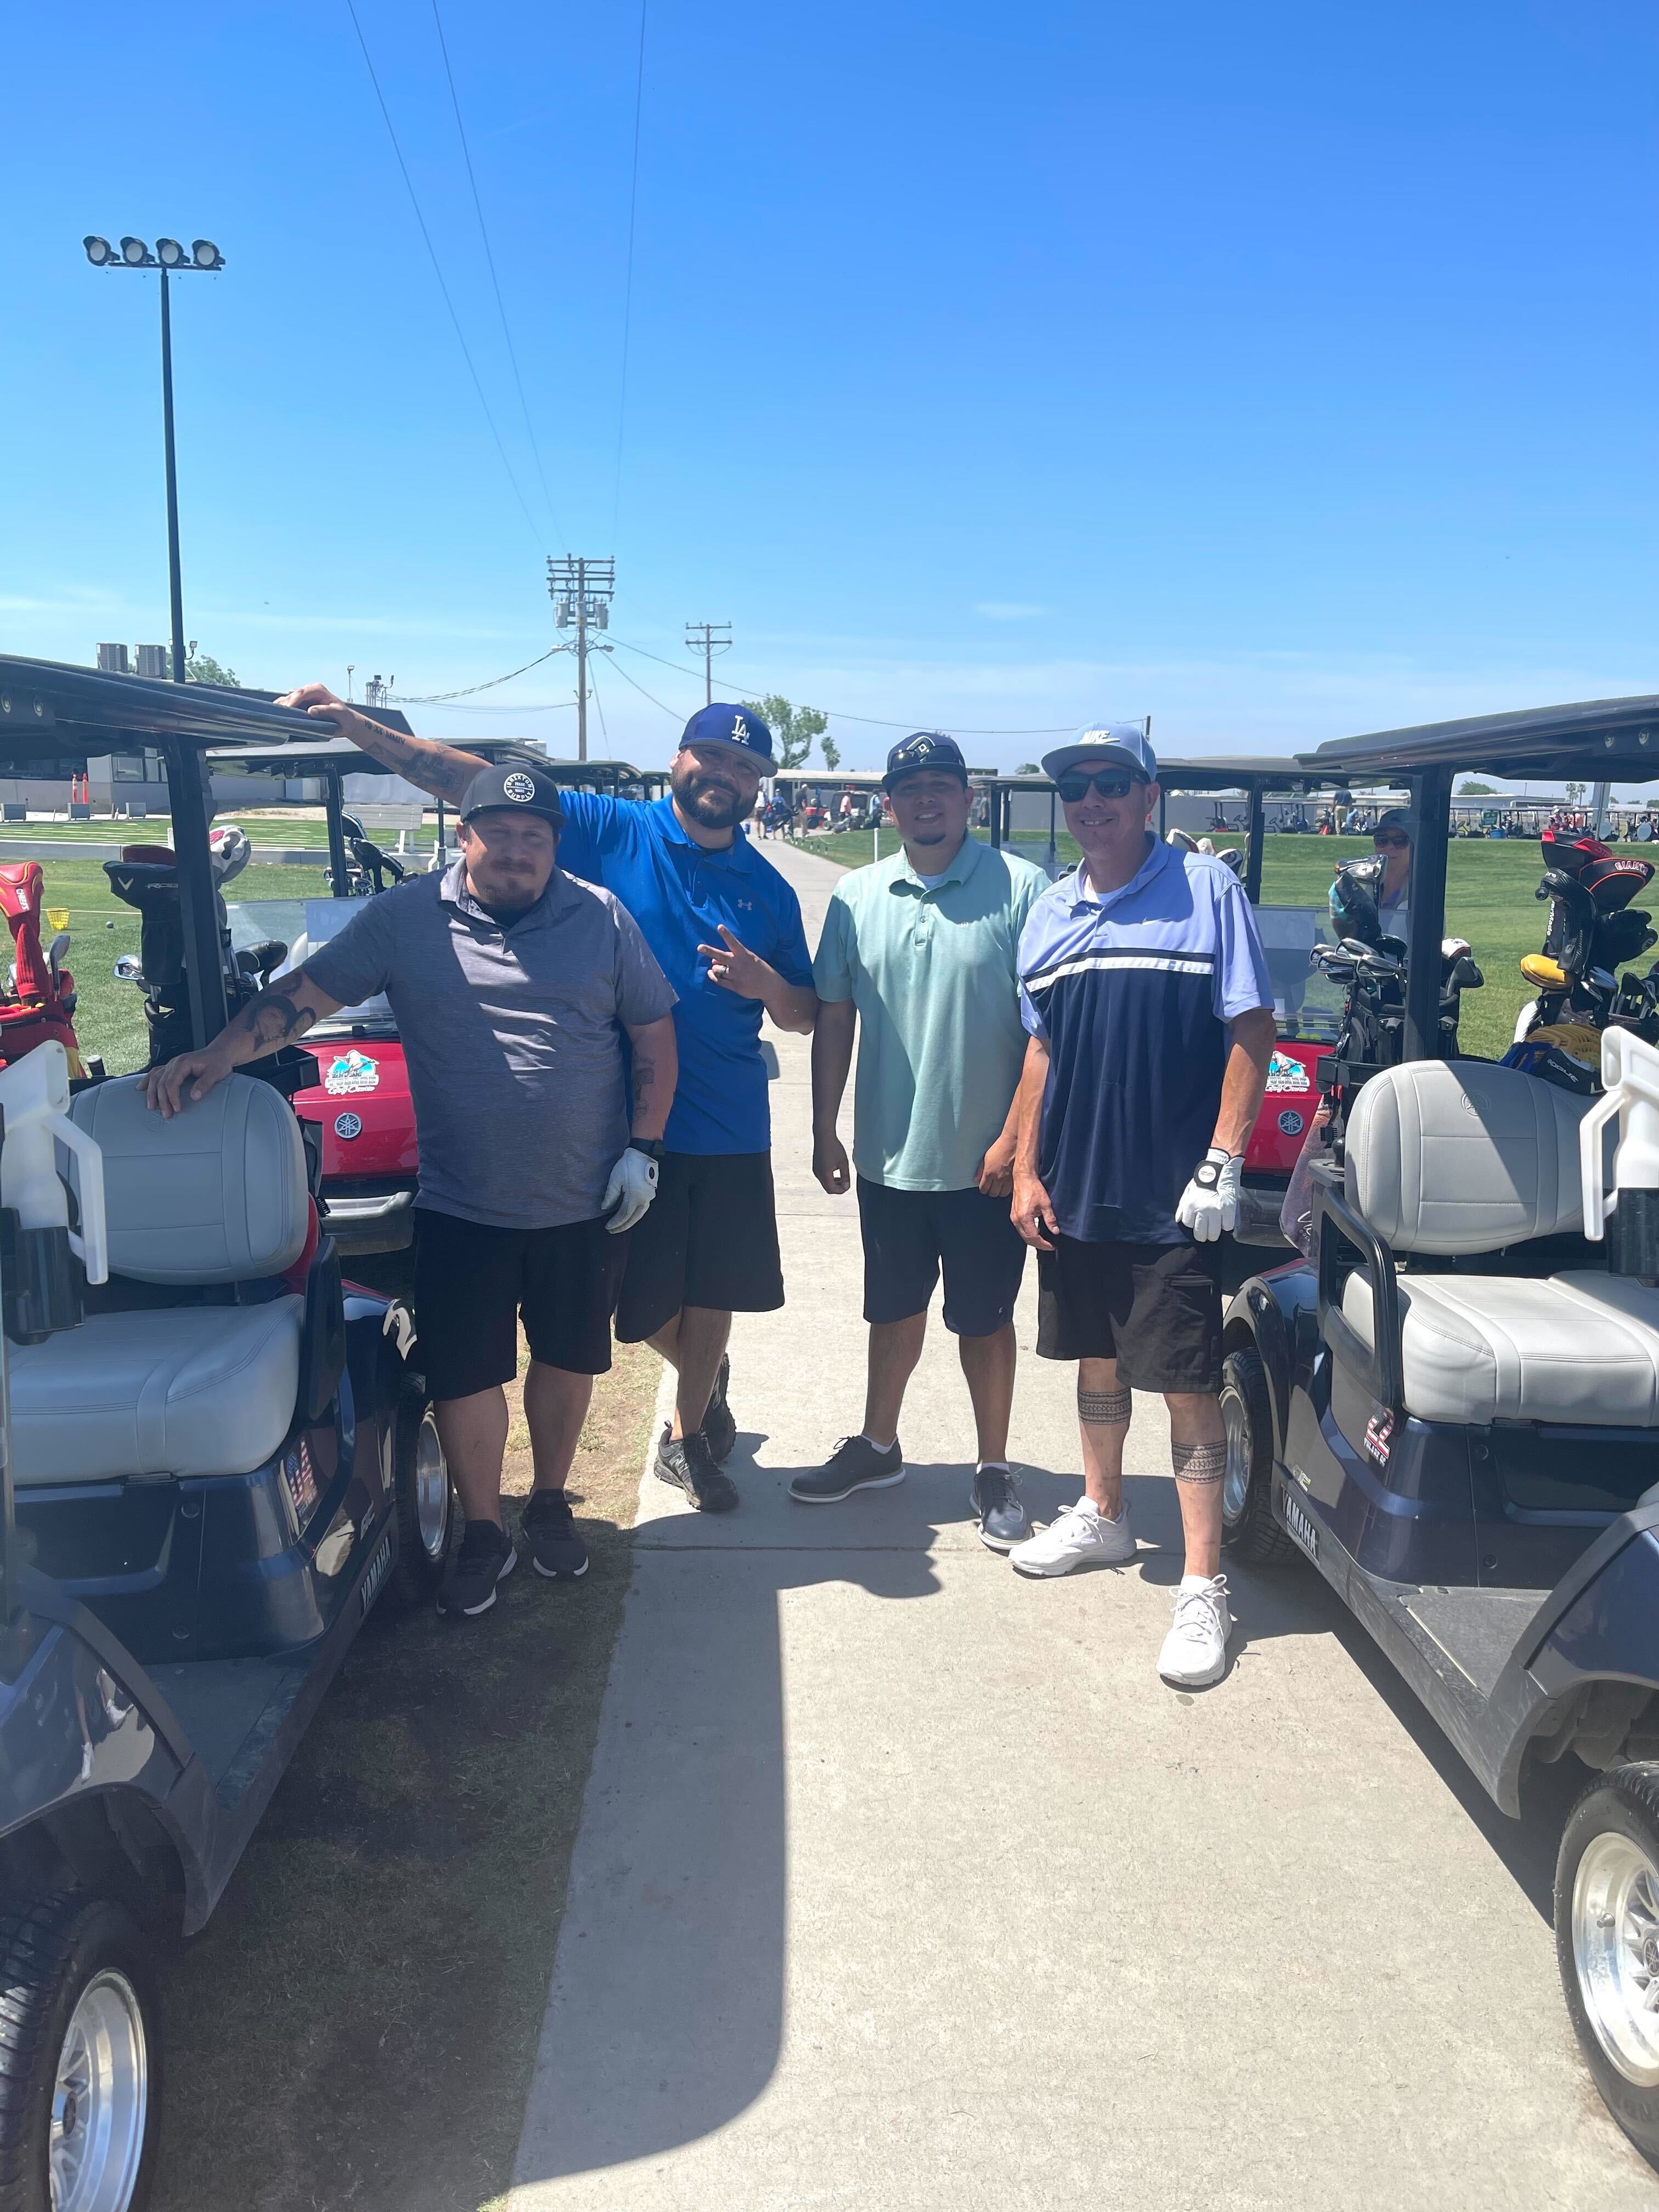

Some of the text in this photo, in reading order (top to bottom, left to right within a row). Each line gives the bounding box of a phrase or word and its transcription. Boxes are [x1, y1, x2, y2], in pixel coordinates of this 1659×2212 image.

[731, 715, 751, 746] LA
[1082, 730, 1110, 741] NIKE
[506, 775, 532, 788] BRIXTON
[507, 789, 532, 799] SUPPLY
[1614, 860, 1649, 876] GIANTS
[15, 888, 30, 911] CHIEFS
[1547, 1058, 1579, 1082] ROGUE
[328, 1076, 376, 1086] TULARE
[1268, 1077, 1308, 1086] ULARE
[1282, 1488, 1317, 1557] YAMAHA
[361, 1536, 391, 1612] YAMAHA
